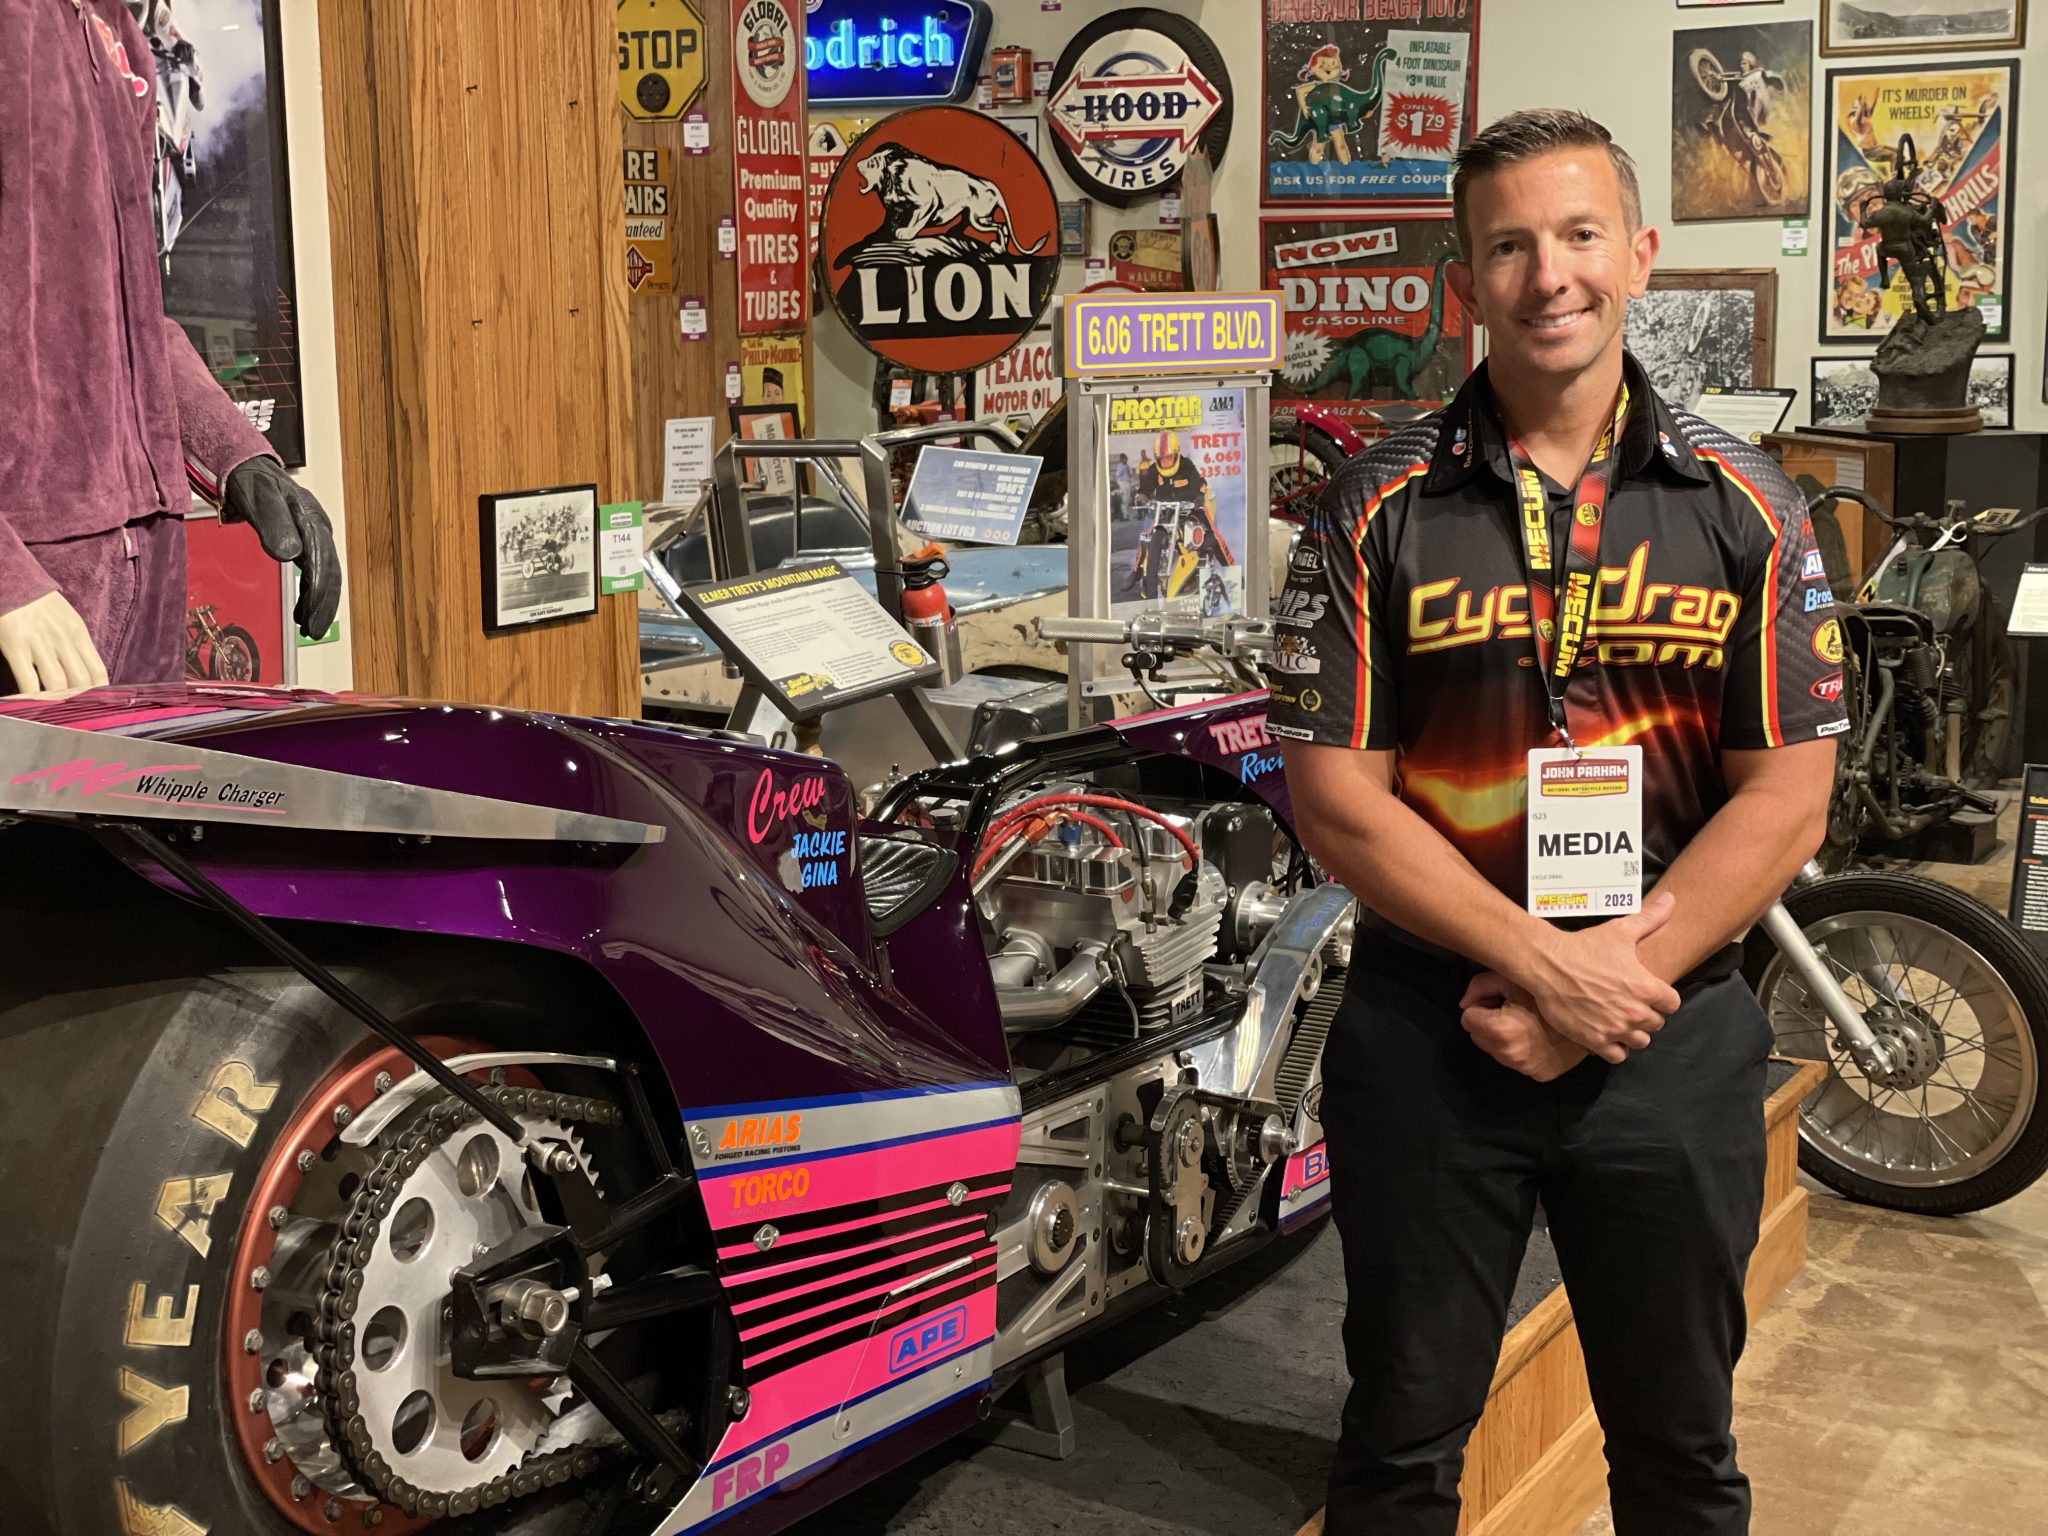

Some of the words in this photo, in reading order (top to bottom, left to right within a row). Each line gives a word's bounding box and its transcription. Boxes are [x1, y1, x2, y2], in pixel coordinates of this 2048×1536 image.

[744, 1, 788, 34] GLOBAL
[1409, 41, 1451, 55] INFLATABLE
[1395, 57, 1401, 69] 4
[1403, 57, 1421, 70] FOOT
[1422, 58, 1460, 72] DINOSAUR
[1425, 76, 1448, 88] VALUE
[1882, 89, 1902, 103] IT'S
[1905, 88, 1948, 102] MURDER
[1952, 86, 1967, 100] ON
[1083, 91, 1187, 122] HOOD
[1889, 106, 1935, 121] WHEELS!
[737, 119, 800, 155] GLOBAL
[740, 169, 801, 190] Premium
[1094, 157, 1175, 188] TIRES
[1273, 177, 1301, 185] ASK
[1306, 176, 1324, 185] US
[1329, 176, 1355, 185] FOR
[1360, 175, 1396, 184] FREE
[625, 185, 666, 214] AIRS
[744, 197, 797, 222] Quality
[746, 234, 798, 264] TIRES
[1279, 232, 1393, 262] NOW!
[769, 270, 777, 284] &
[1838, 257, 1860, 275] The
[745, 290, 800, 321] TUBES
[857, 262, 1032, 325] LION
[1279, 275, 1430, 312] DINO
[1088, 315, 1131, 355] 6.06
[1138, 312, 1205, 352] TRETT
[1213, 310, 1265, 350] BLVD.
[1302, 316, 1406, 326] GASOLINE
[742, 347, 769, 367] PHILIP
[770, 345, 800, 364] MORRIS
[1295, 343, 1304, 351] AT
[984, 391, 1028, 414] MOTOR
[1032, 387, 1053, 410] OIL
[1111, 396, 1201, 421] PROSTAR
[1209, 396, 1233, 411] AMA
[1273, 406, 1296, 416] FOR
[1112, 416, 1195, 430] REPORT
[1191, 433, 1241, 449] TRETT
[1203, 452, 1241, 464] 6.069
[1200, 465, 1241, 478] 235.10
[996, 483, 1025, 495] 1940'S
[906, 520, 941, 533] AUCTION
[943, 523, 959, 536] LOT
[1518, 470, 1551, 569] MECUM
[613, 533, 631, 543] T144
[698, 590, 732, 604] ELMER
[731, 580, 767, 597] TRETT'S
[765, 570, 812, 590] MOUNTAIN
[811, 565, 841, 580] MAGIC
[1554, 572, 1591, 677] MECUM
[1208, 713, 1276, 755] TRET
[1542, 767, 1574, 779] JOHN
[1577, 765, 1627, 778] PARHAM
[136, 776, 208, 802] Whipple
[218, 784, 285, 807] Charger
[748, 768, 825, 843] Crew
[791, 831, 846, 859] JACKIE
[1538, 831, 1633, 857] MEDIA
[801, 860, 837, 888] GINA
[1536, 893, 1588, 906] MECUM
[1605, 894, 1633, 907] 2023
[1176, 990, 1200, 1015] TRETT
[719, 1113, 802, 1150] ARIAS
[715, 1151, 743, 1160] FORGED
[744, 1148, 771, 1157] RACING
[772, 1145, 801, 1153] PISTONS
[730, 1167, 810, 1208] TORCO
[117, 1061, 280, 1456] YEAR
[896, 1316, 958, 1363] APE
[711, 1442, 790, 1514] FRP
